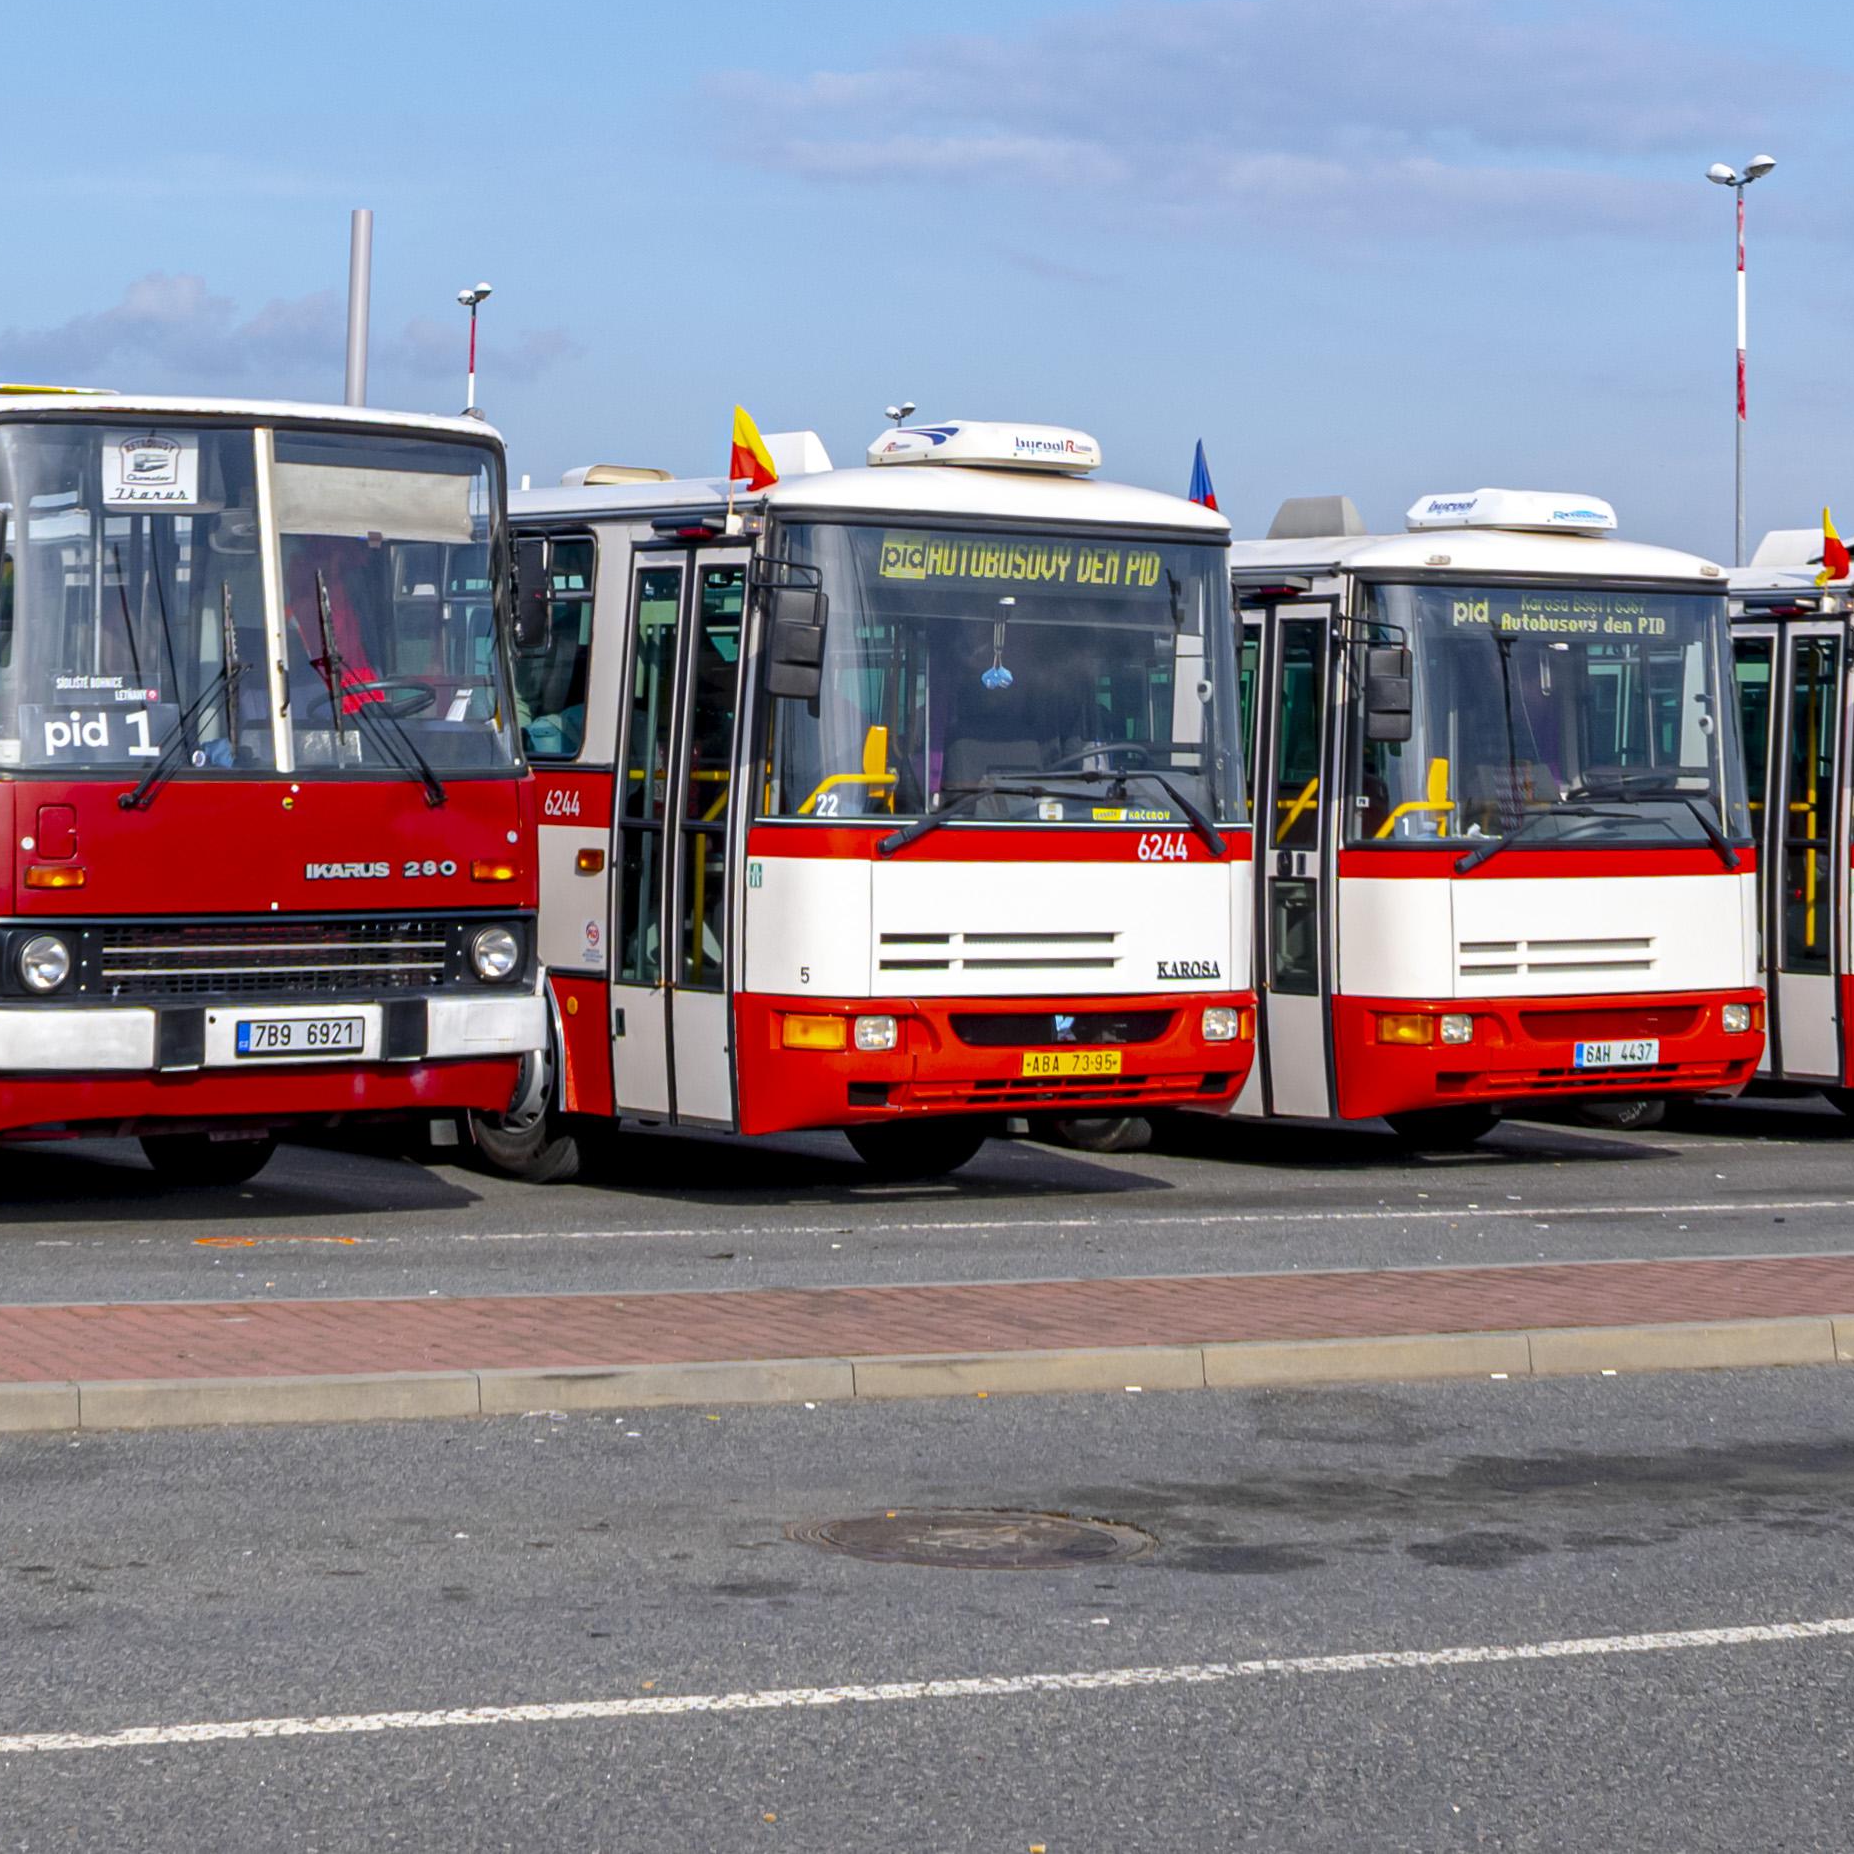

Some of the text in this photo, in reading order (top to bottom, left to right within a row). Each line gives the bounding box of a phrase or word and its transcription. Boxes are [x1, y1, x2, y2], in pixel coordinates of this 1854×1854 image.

[108, 487, 189, 500] Ikarus
[1076, 546, 1121, 584] DEN
[1124, 550, 1161, 586] PID
[1453, 596, 1489, 626] pid
[1501, 612, 1665, 634] Autobusový den PID
[44, 710, 161, 756] pid 1
[544, 789, 581, 817] 6244
[816, 793, 839, 817] 22
[1402, 817, 1410, 836] 1
[1137, 833, 1188, 861] 6244
[305, 860, 458, 879] IKARUS 280
[800, 966, 810, 984] 5
[1157, 961, 1221, 979] KAROSA
[255, 1024, 292, 1047] 7B9
[306, 1022, 353, 1045] 6921
[1032, 1055, 1059, 1072] ABA
[1587, 1042, 1653, 1063] 6AH 4437
